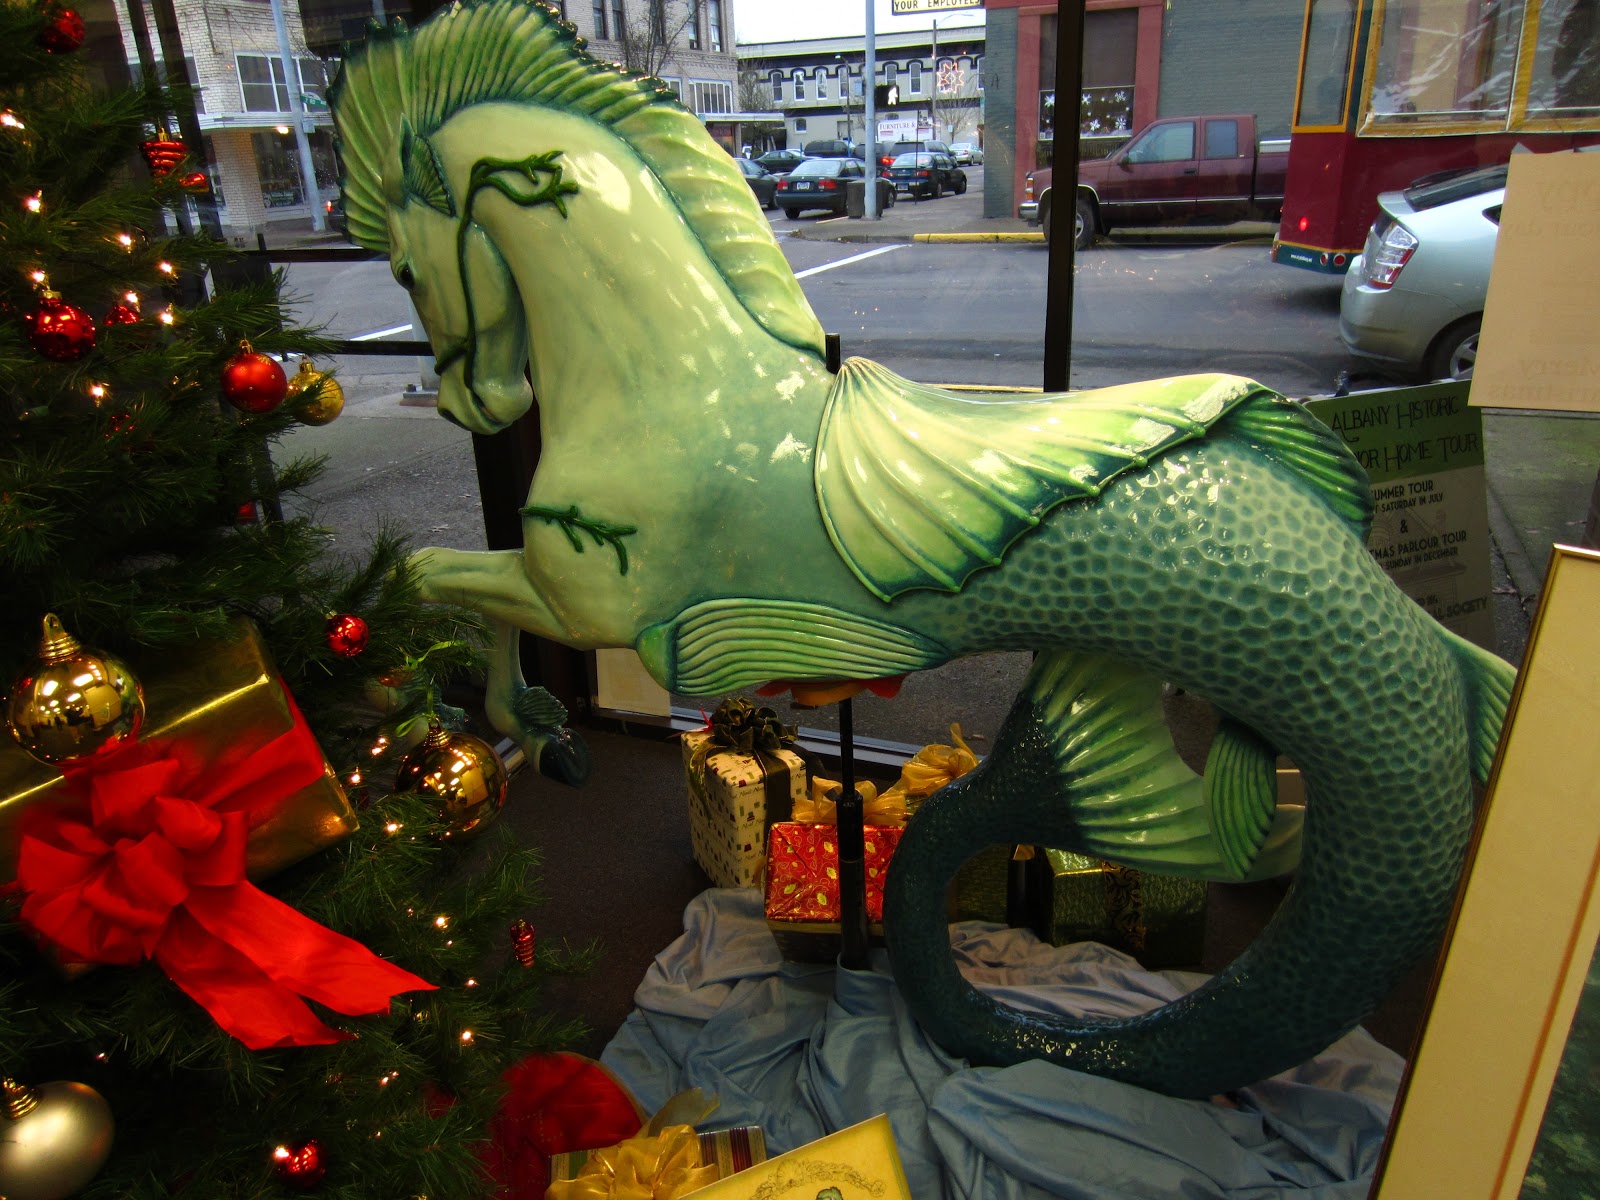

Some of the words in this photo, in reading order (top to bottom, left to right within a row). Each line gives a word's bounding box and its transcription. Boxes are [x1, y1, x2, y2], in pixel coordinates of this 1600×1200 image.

[894, 0, 918, 11] YOUR
[879, 122, 911, 130] FURNITURE
[1332, 404, 1391, 443] ALBANY
[1397, 396, 1459, 430] HISTORIC
[1384, 439, 1433, 472] HOME
[1437, 433, 1478, 463] TOUR
[1371, 485, 1405, 501] UMMER
[1408, 480, 1434, 495] TOUR
[1381, 497, 1417, 513] SATURDAY
[1419, 495, 1426, 506] IN
[1428, 492, 1444, 504] JULY
[1400, 520, 1408, 533] &
[1397, 536, 1439, 555] PARLOUR
[1442, 530, 1467, 545] TOUR
[1386, 556, 1412, 570] SUNDAY
[1414, 554, 1422, 564] IN
[1424, 547, 1458, 562] DECEMBER
[1446, 596, 1488, 617] SOCIETY
